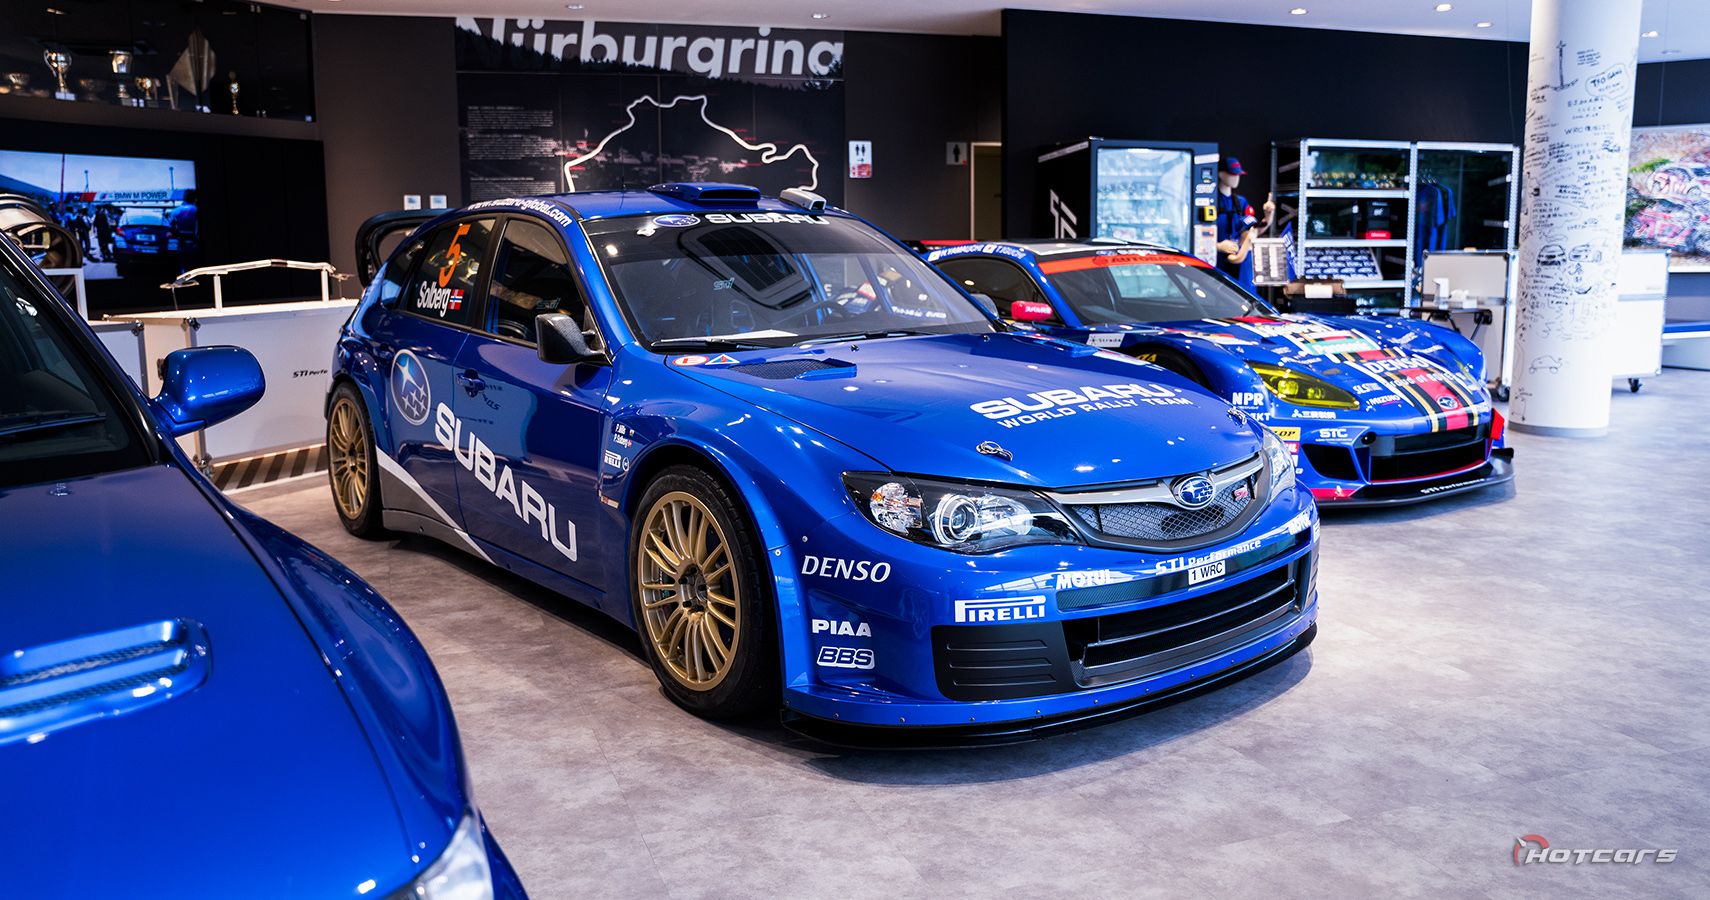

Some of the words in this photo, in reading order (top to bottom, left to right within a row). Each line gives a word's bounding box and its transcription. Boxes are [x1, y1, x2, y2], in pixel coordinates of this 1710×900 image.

[704, 212, 830, 225] SUBARU
[438, 223, 470, 288] 5
[416, 280, 452, 318] Solberg
[969, 383, 1176, 420] SUBARU
[996, 407, 1077, 429] WORLD
[1078, 398, 1139, 413] RALLY
[1140, 396, 1194, 406] TEAM
[1232, 391, 1264, 407] NPR
[1319, 428, 1349, 439] STC
[434, 401, 578, 563] SUBARU
[801, 554, 892, 584] DENSO
[1155, 556, 1186, 576] STI
[1187, 539, 1262, 566] Performance
[1201, 562, 1224, 580] WRC
[1056, 569, 1111, 591] MOTUL
[954, 595, 1047, 623] PIRELLI
[812, 618, 872, 638] PIAA
[817, 646, 876, 670] BBS
